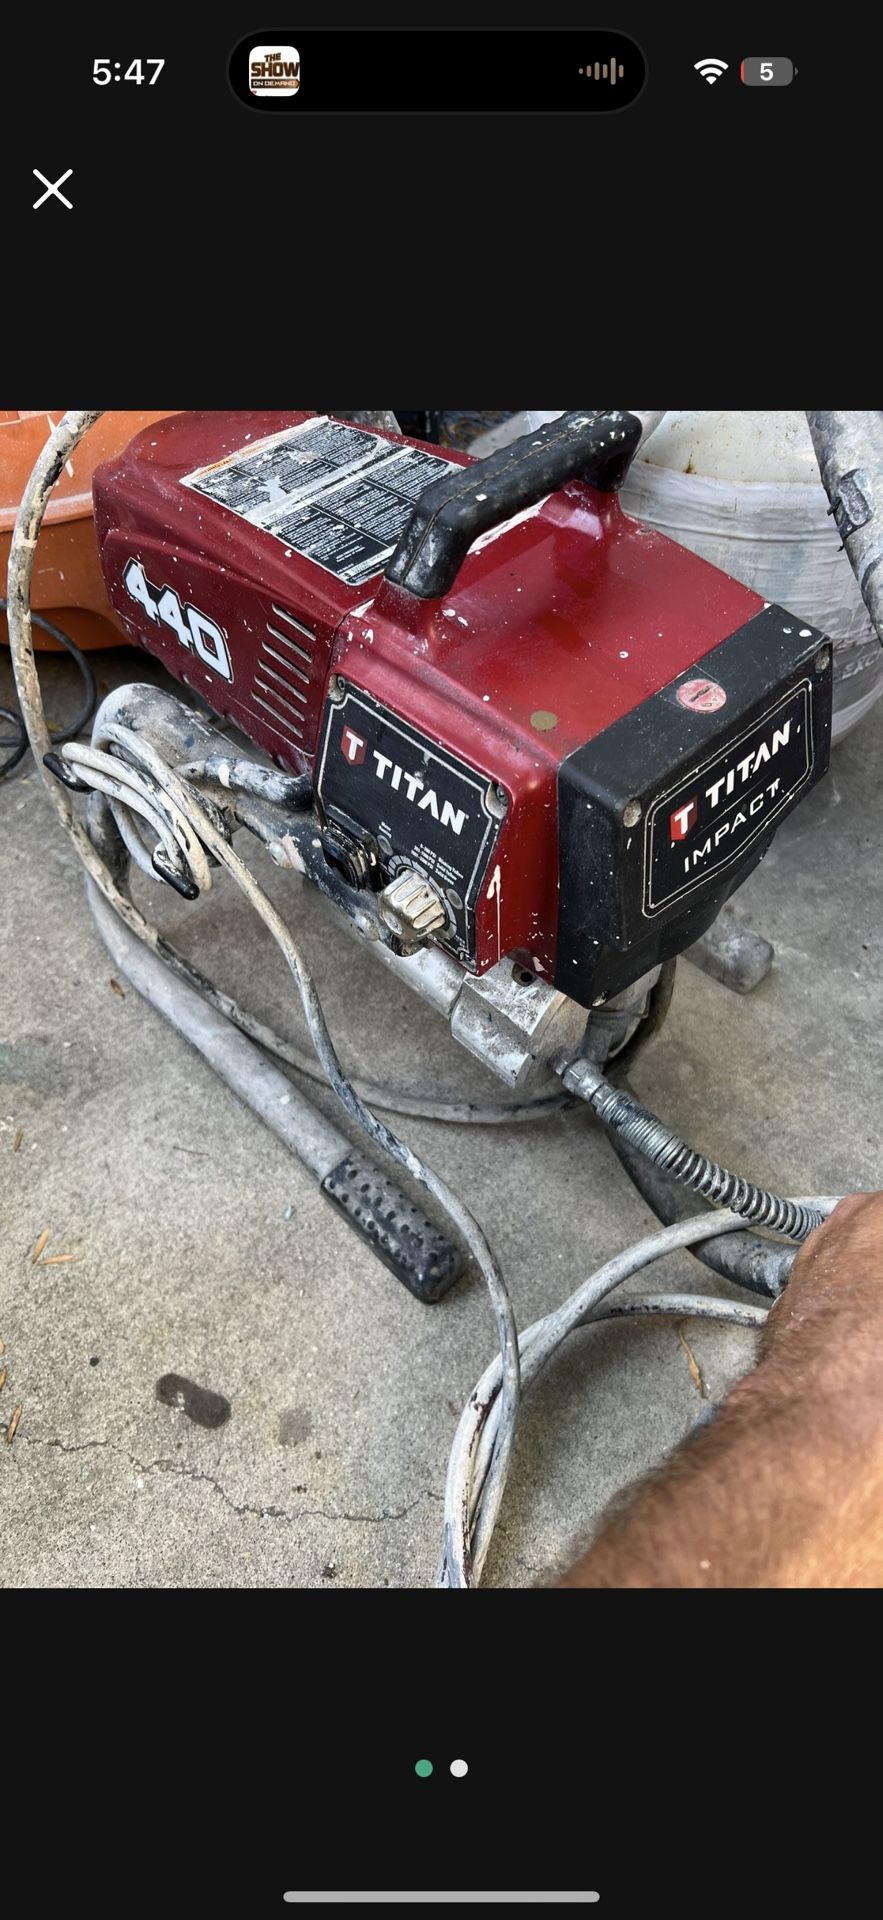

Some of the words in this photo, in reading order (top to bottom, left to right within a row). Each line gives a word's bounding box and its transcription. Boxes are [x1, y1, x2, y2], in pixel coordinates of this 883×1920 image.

[124, 560, 232, 681] 440
[373, 750, 466, 835] TITAN
[705, 720, 791, 808] TITAN
[684, 778, 781, 873] IMPACT
